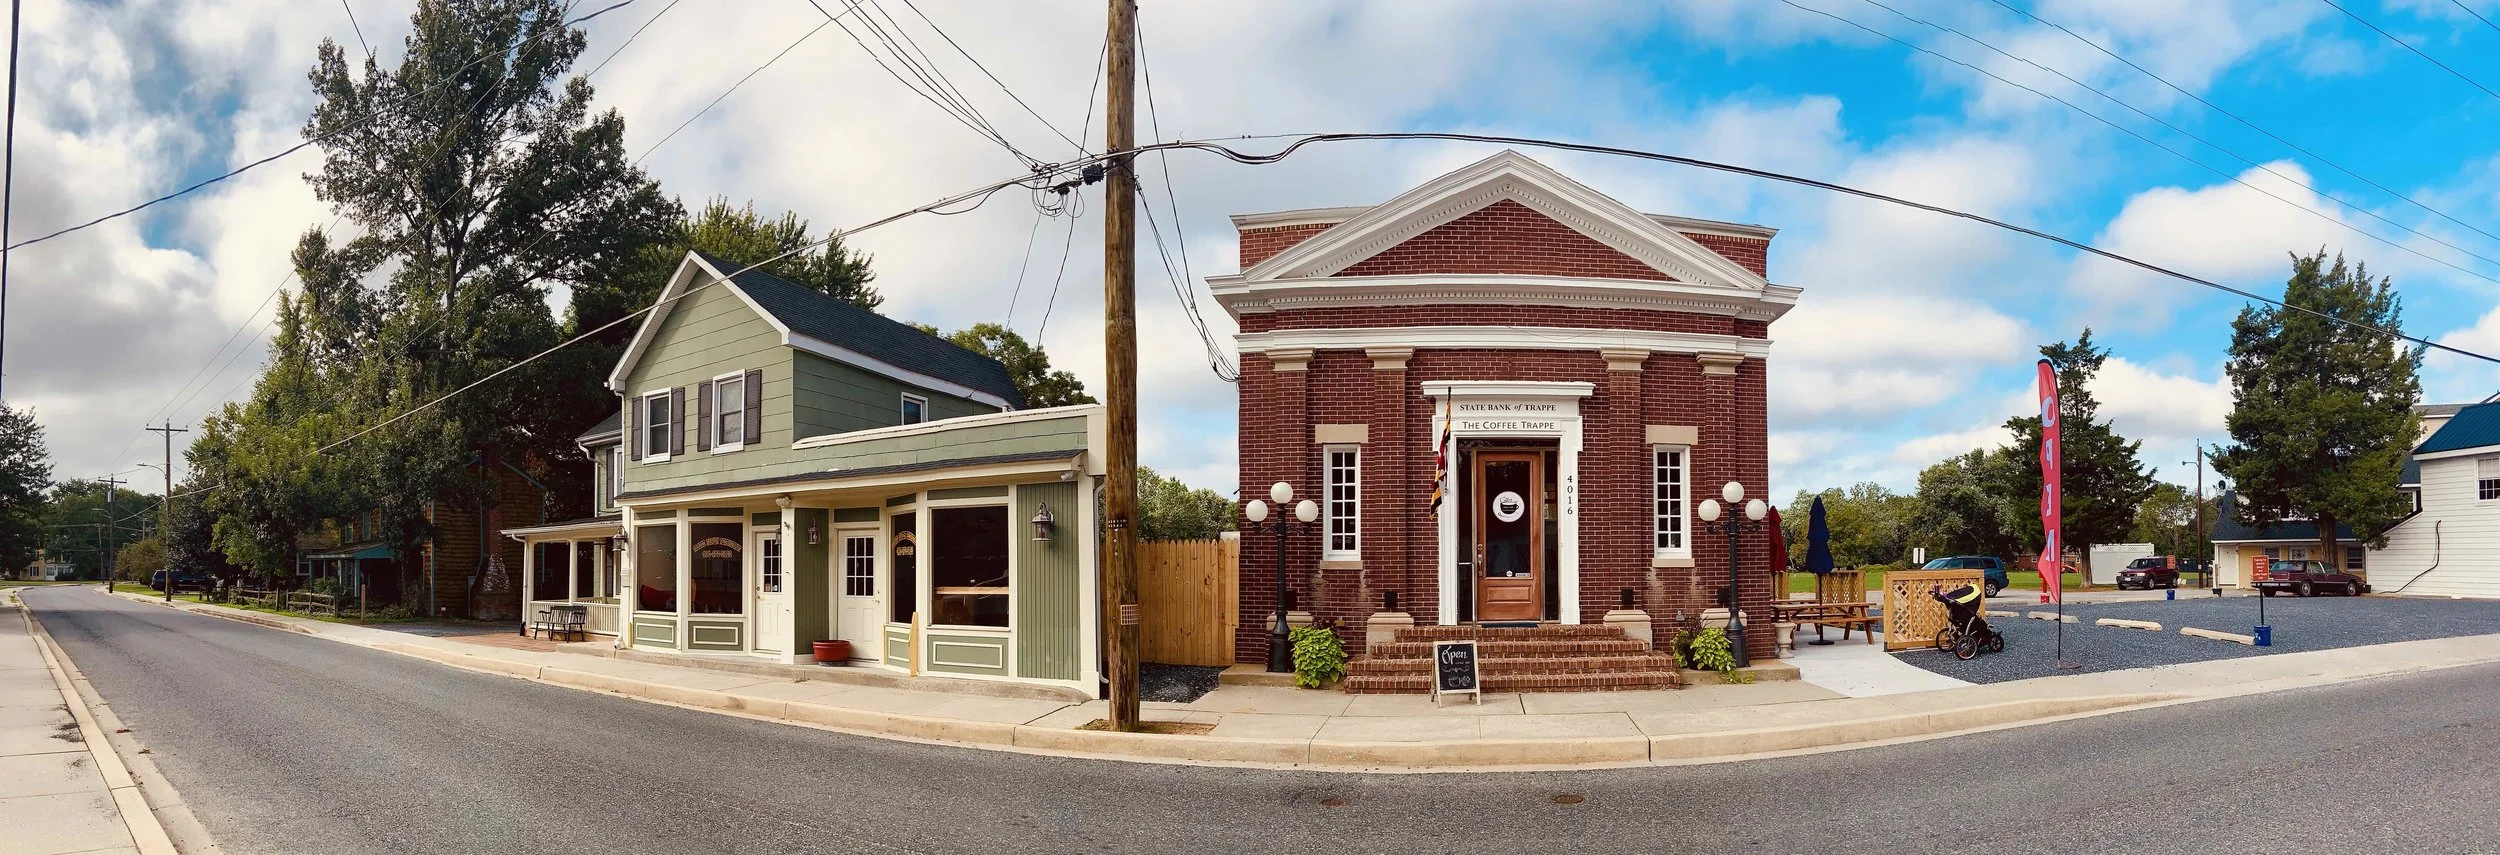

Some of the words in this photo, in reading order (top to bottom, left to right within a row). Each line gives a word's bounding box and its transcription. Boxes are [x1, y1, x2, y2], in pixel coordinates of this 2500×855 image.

[1514, 403, 1523, 412] of
[1462, 421, 1480, 429] THE
[1482, 421, 1518, 429] COFFEE
[1521, 421, 1555, 429] TRAPPE
[1441, 645, 1469, 665] Open
